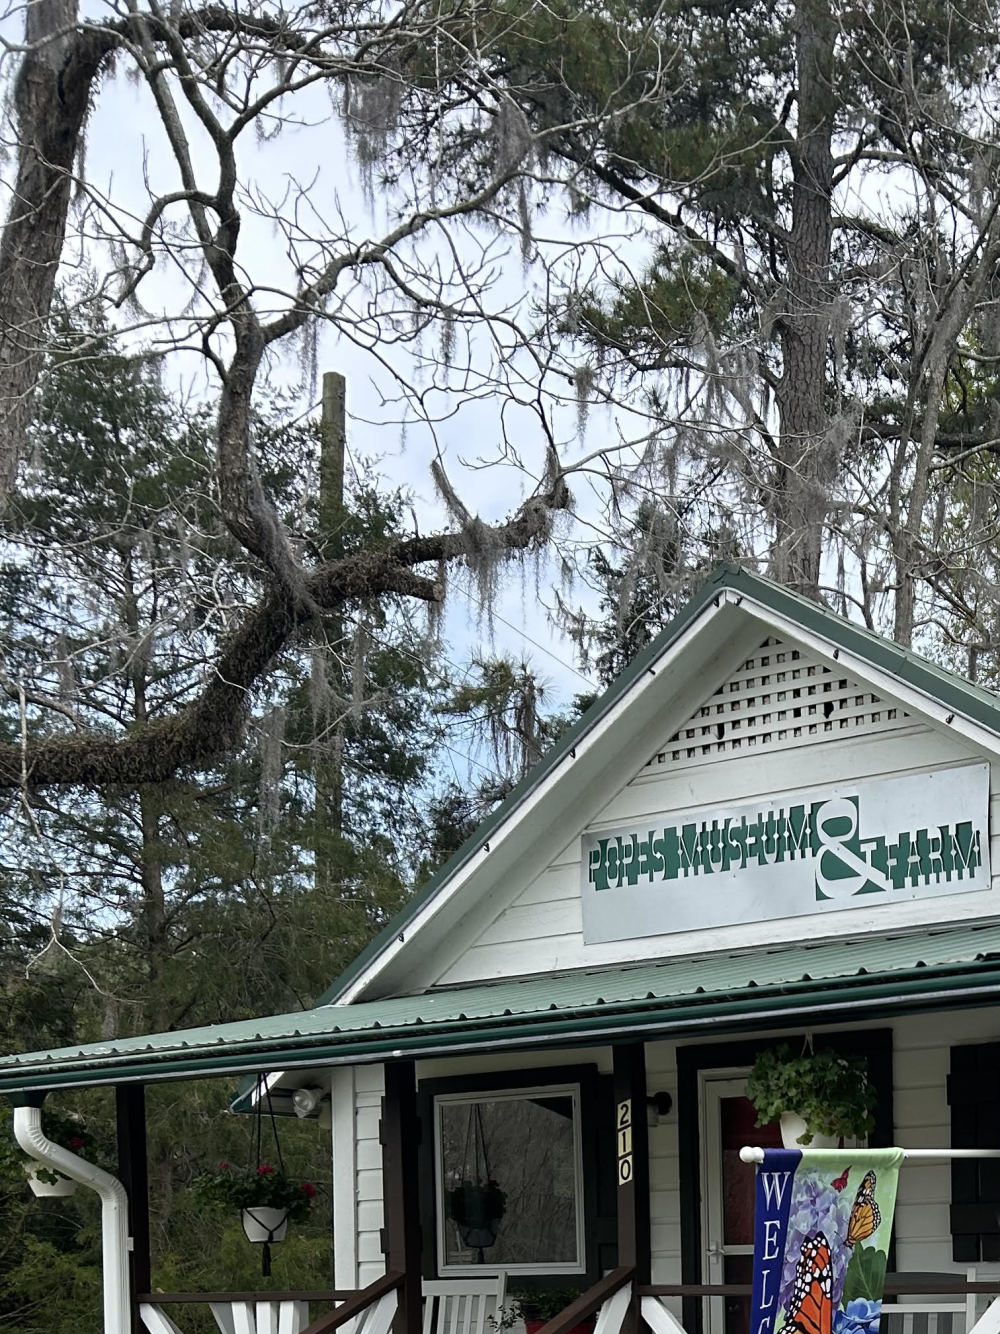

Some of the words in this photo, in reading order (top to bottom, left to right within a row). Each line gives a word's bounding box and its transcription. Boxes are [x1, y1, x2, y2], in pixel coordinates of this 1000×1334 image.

[589, 829, 666, 890] POPES
[676, 803, 812, 878] MUSEUM
[816, 798, 889, 899] &
[884, 822, 984, 890] FARM
[619, 1103, 631, 1181] 210
